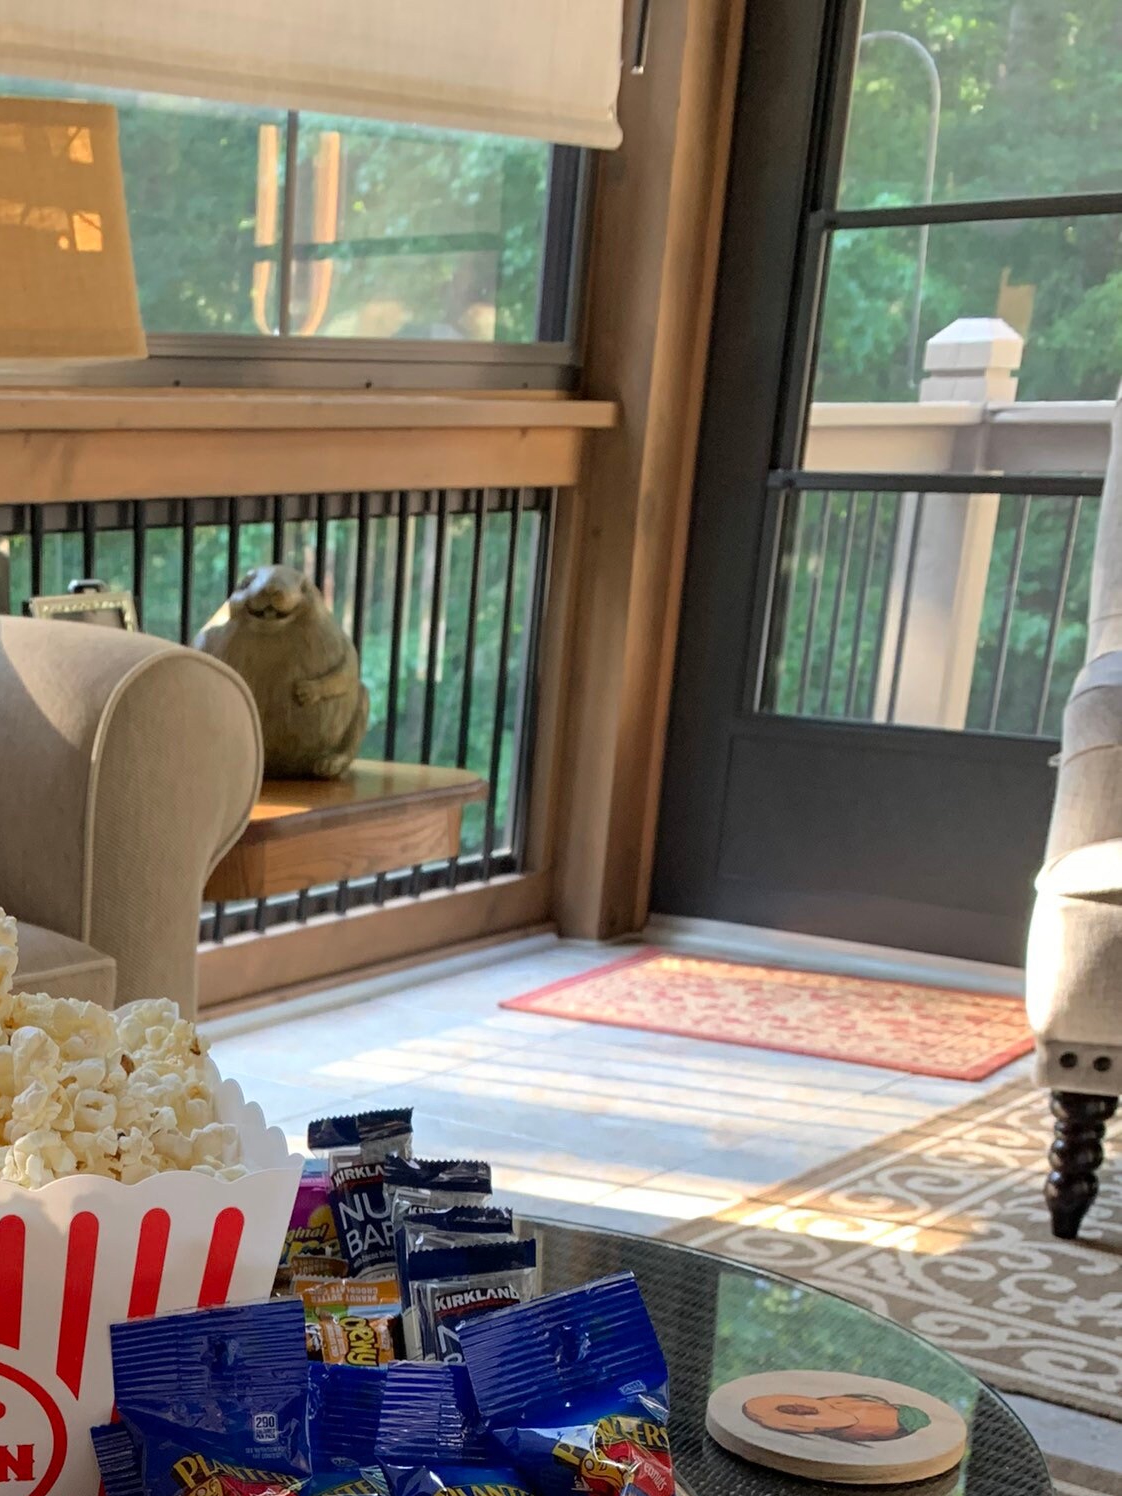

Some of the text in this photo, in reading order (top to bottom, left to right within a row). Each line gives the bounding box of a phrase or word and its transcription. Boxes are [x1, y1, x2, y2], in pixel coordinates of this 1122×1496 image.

[333, 1163, 385, 1187] KIRKLA
[338, 1192, 392, 1230] NU
[286, 1224, 327, 1243] ginal
[435, 1284, 520, 1312] KIRKLAND
[256, 1416, 275, 1428] 290
